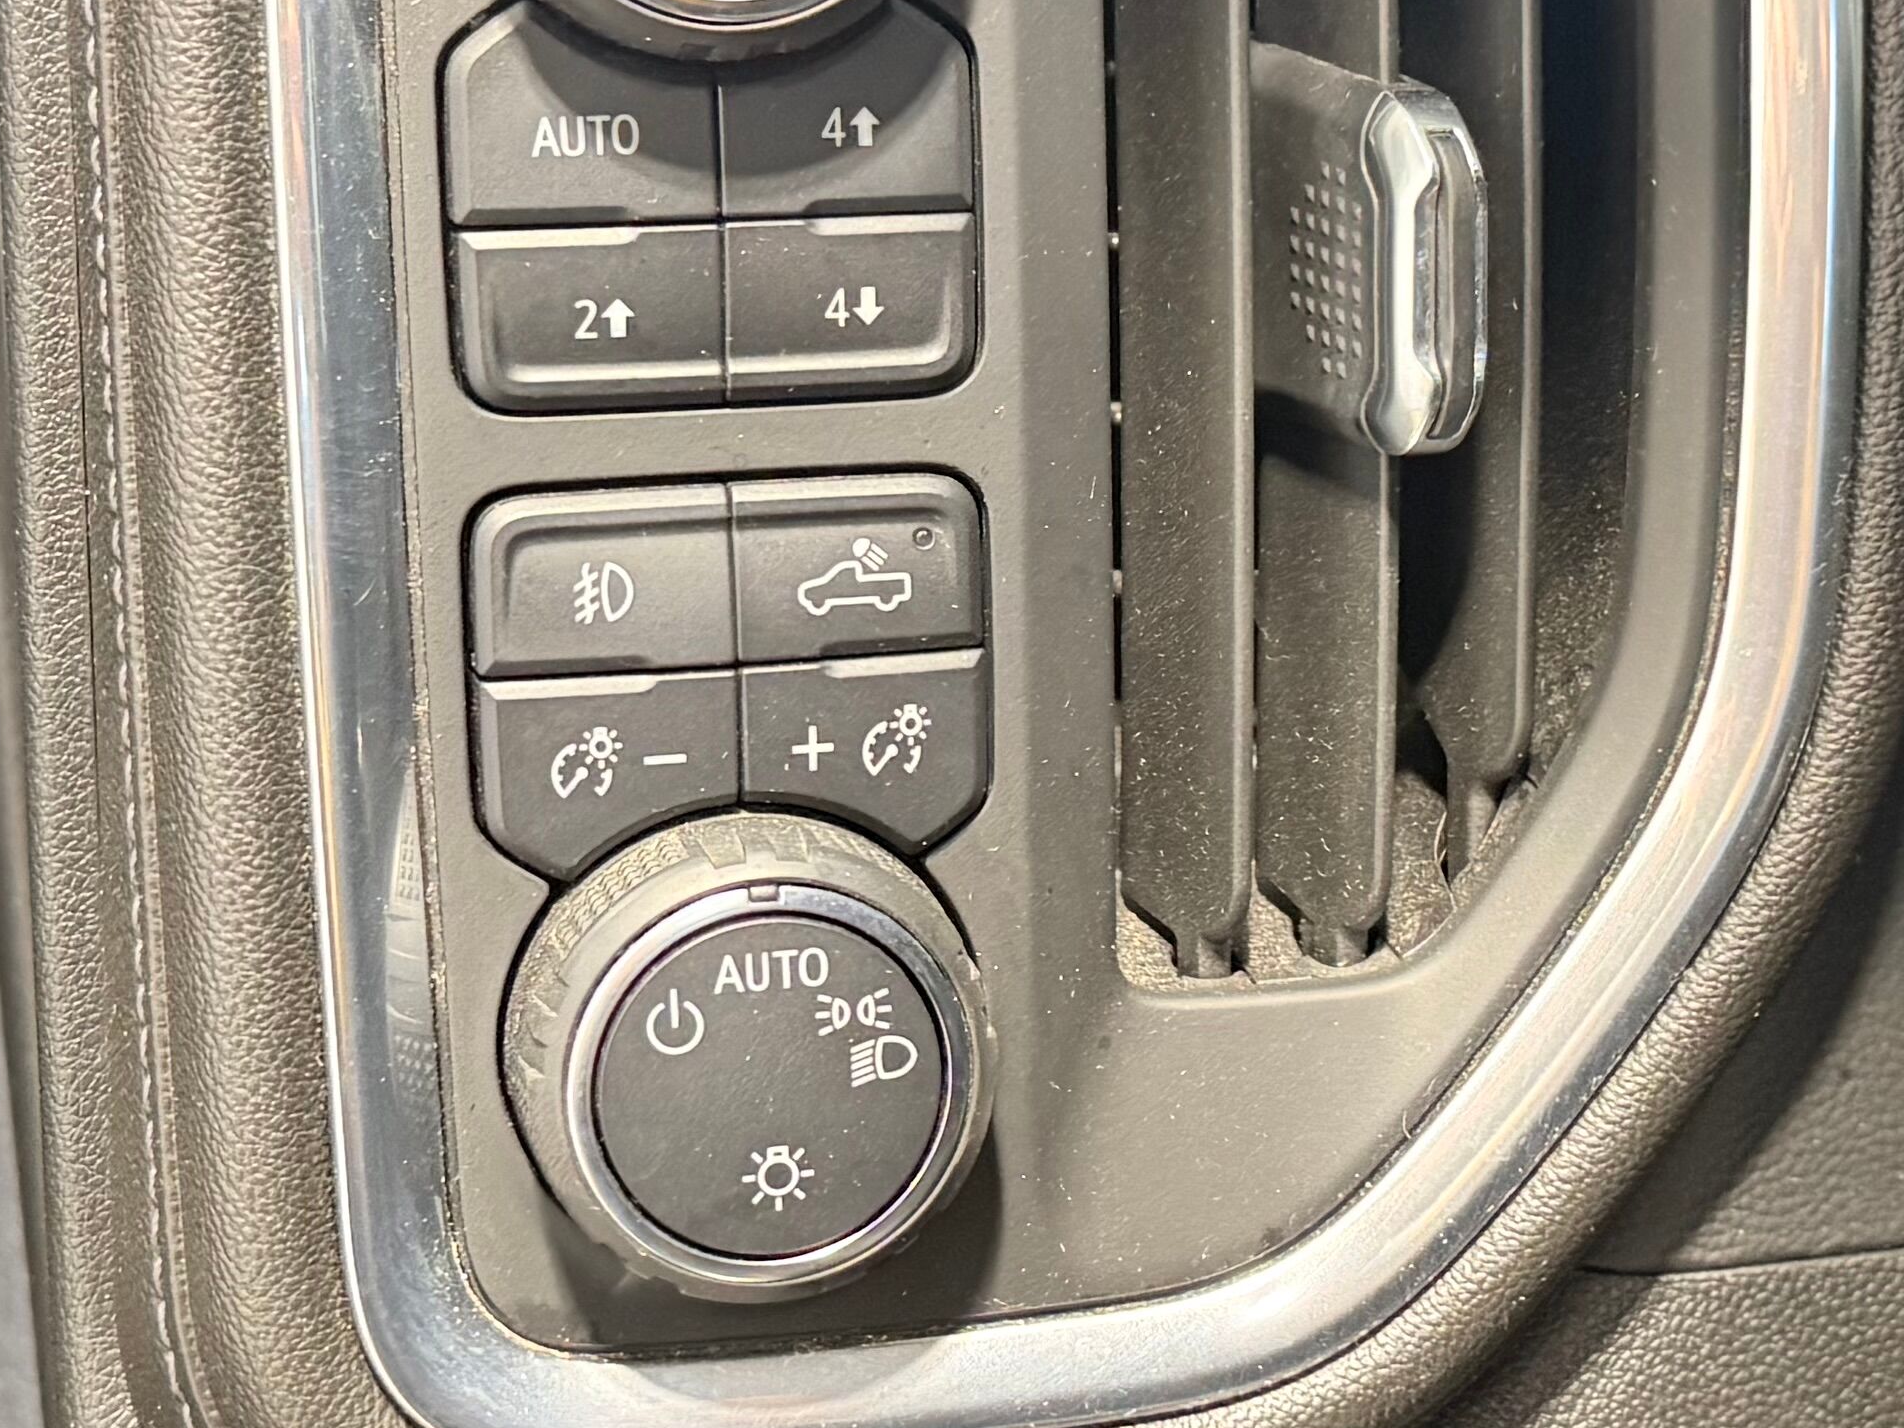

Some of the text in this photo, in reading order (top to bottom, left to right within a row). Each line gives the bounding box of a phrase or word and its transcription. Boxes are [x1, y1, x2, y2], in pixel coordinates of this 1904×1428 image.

[531, 113, 641, 159] AUTO
[821, 108, 846, 147] 4
[573, 300, 599, 340] 2
[824, 288, 850, 328] 4
[714, 946, 830, 993] AUTO
